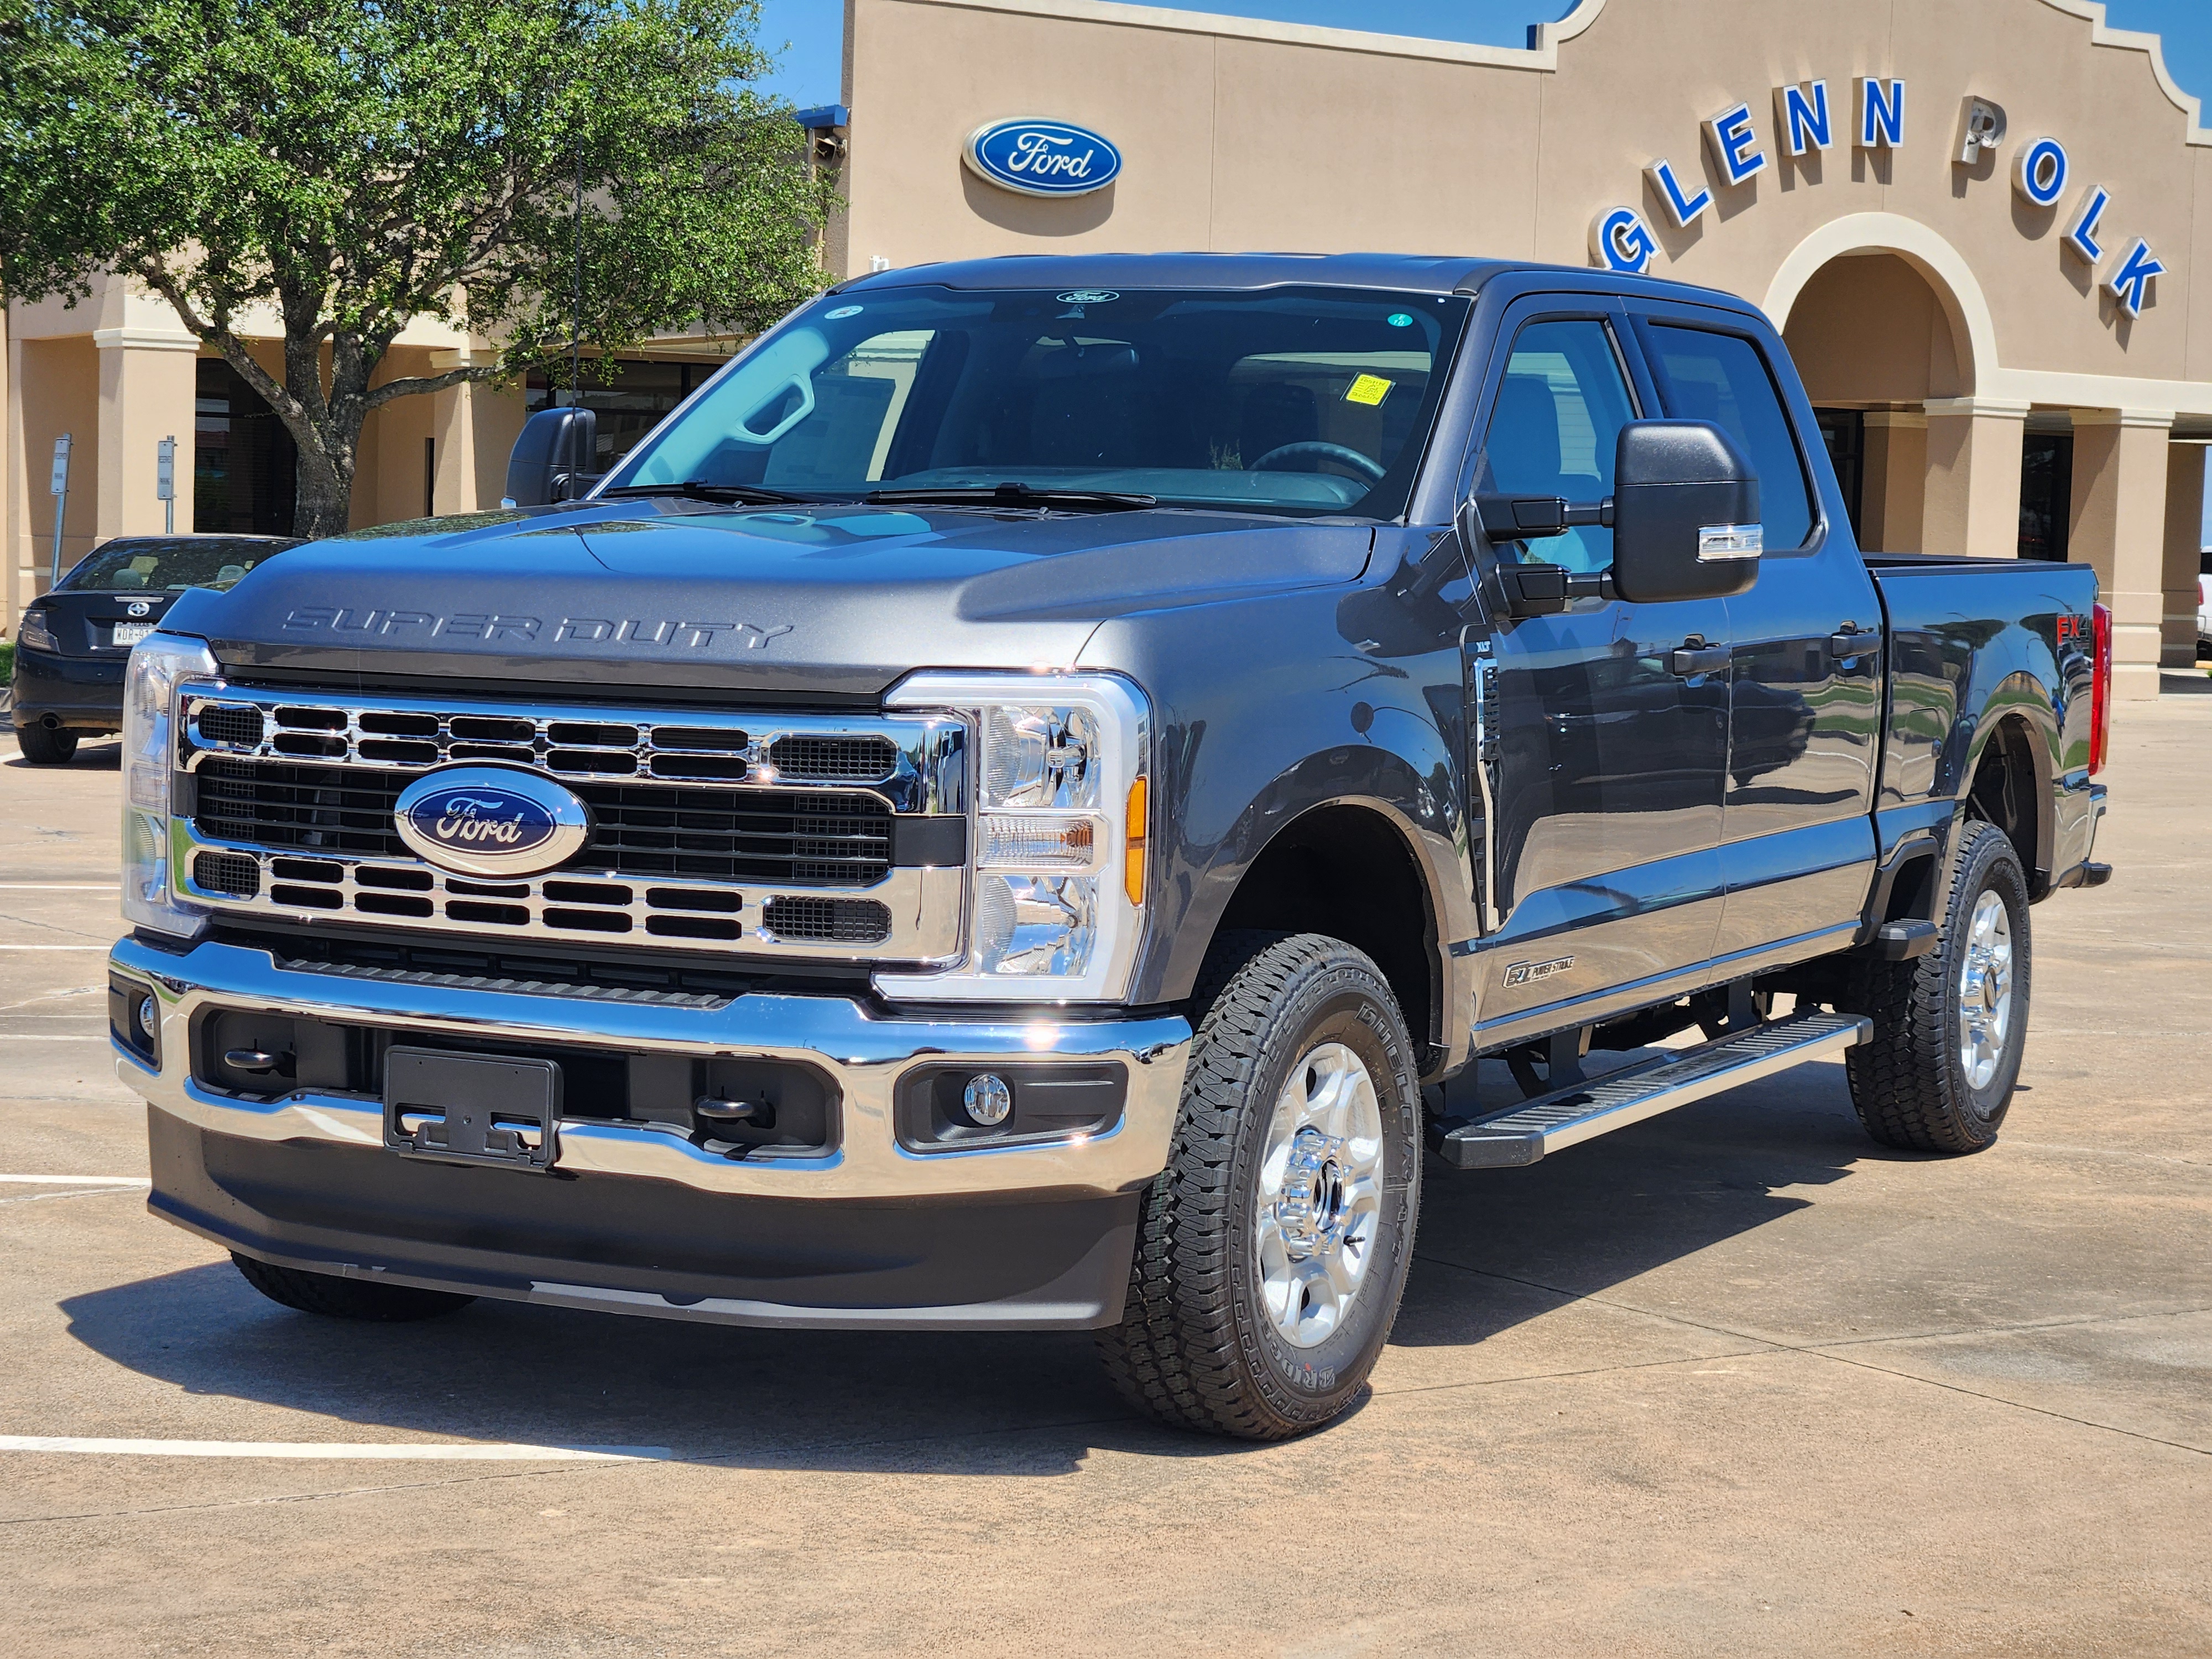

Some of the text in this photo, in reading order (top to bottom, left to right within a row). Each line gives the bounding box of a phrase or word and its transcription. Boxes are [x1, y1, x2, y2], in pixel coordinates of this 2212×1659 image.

[1008, 132, 1094, 178] Ford
[1596, 77, 2169, 320] GLENN POLK
[1065, 291, 1110, 301] Ford
[283, 606, 794, 649] SUPER DUTY
[1475, 640, 1491, 653] XLT
[2057, 614, 2090, 646] FX4
[436, 796, 525, 843] Ford
[1354, 1000, 1415, 1181] DUELER
